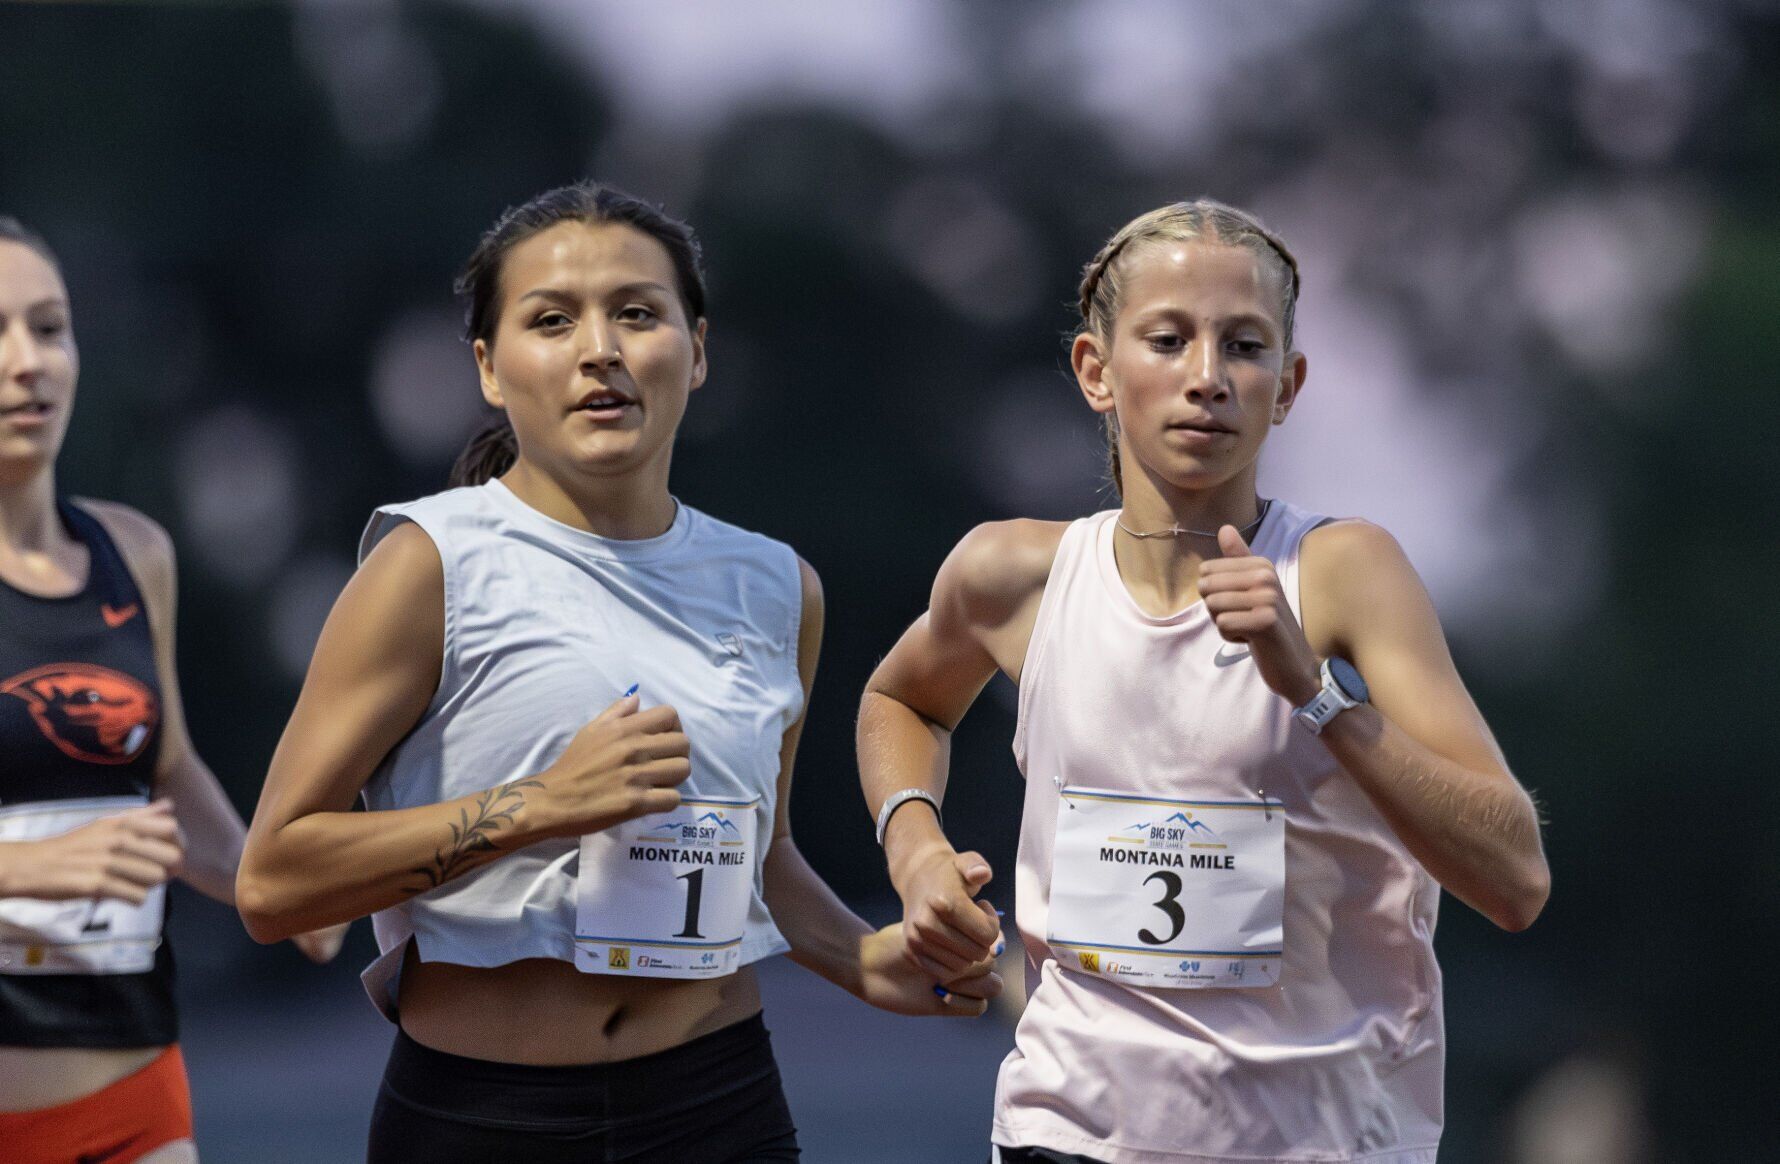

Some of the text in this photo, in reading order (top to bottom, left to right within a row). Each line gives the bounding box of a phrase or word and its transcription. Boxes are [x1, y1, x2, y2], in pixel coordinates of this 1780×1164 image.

[682, 825, 717, 839] BIG SKY
[1150, 826, 1185, 842] BIG SKY
[629, 847, 745, 865] MONTANA MILE
[1100, 848, 1236, 870] MONTANA MILE
[672, 868, 706, 939] 1
[1137, 870, 1186, 946] 3
